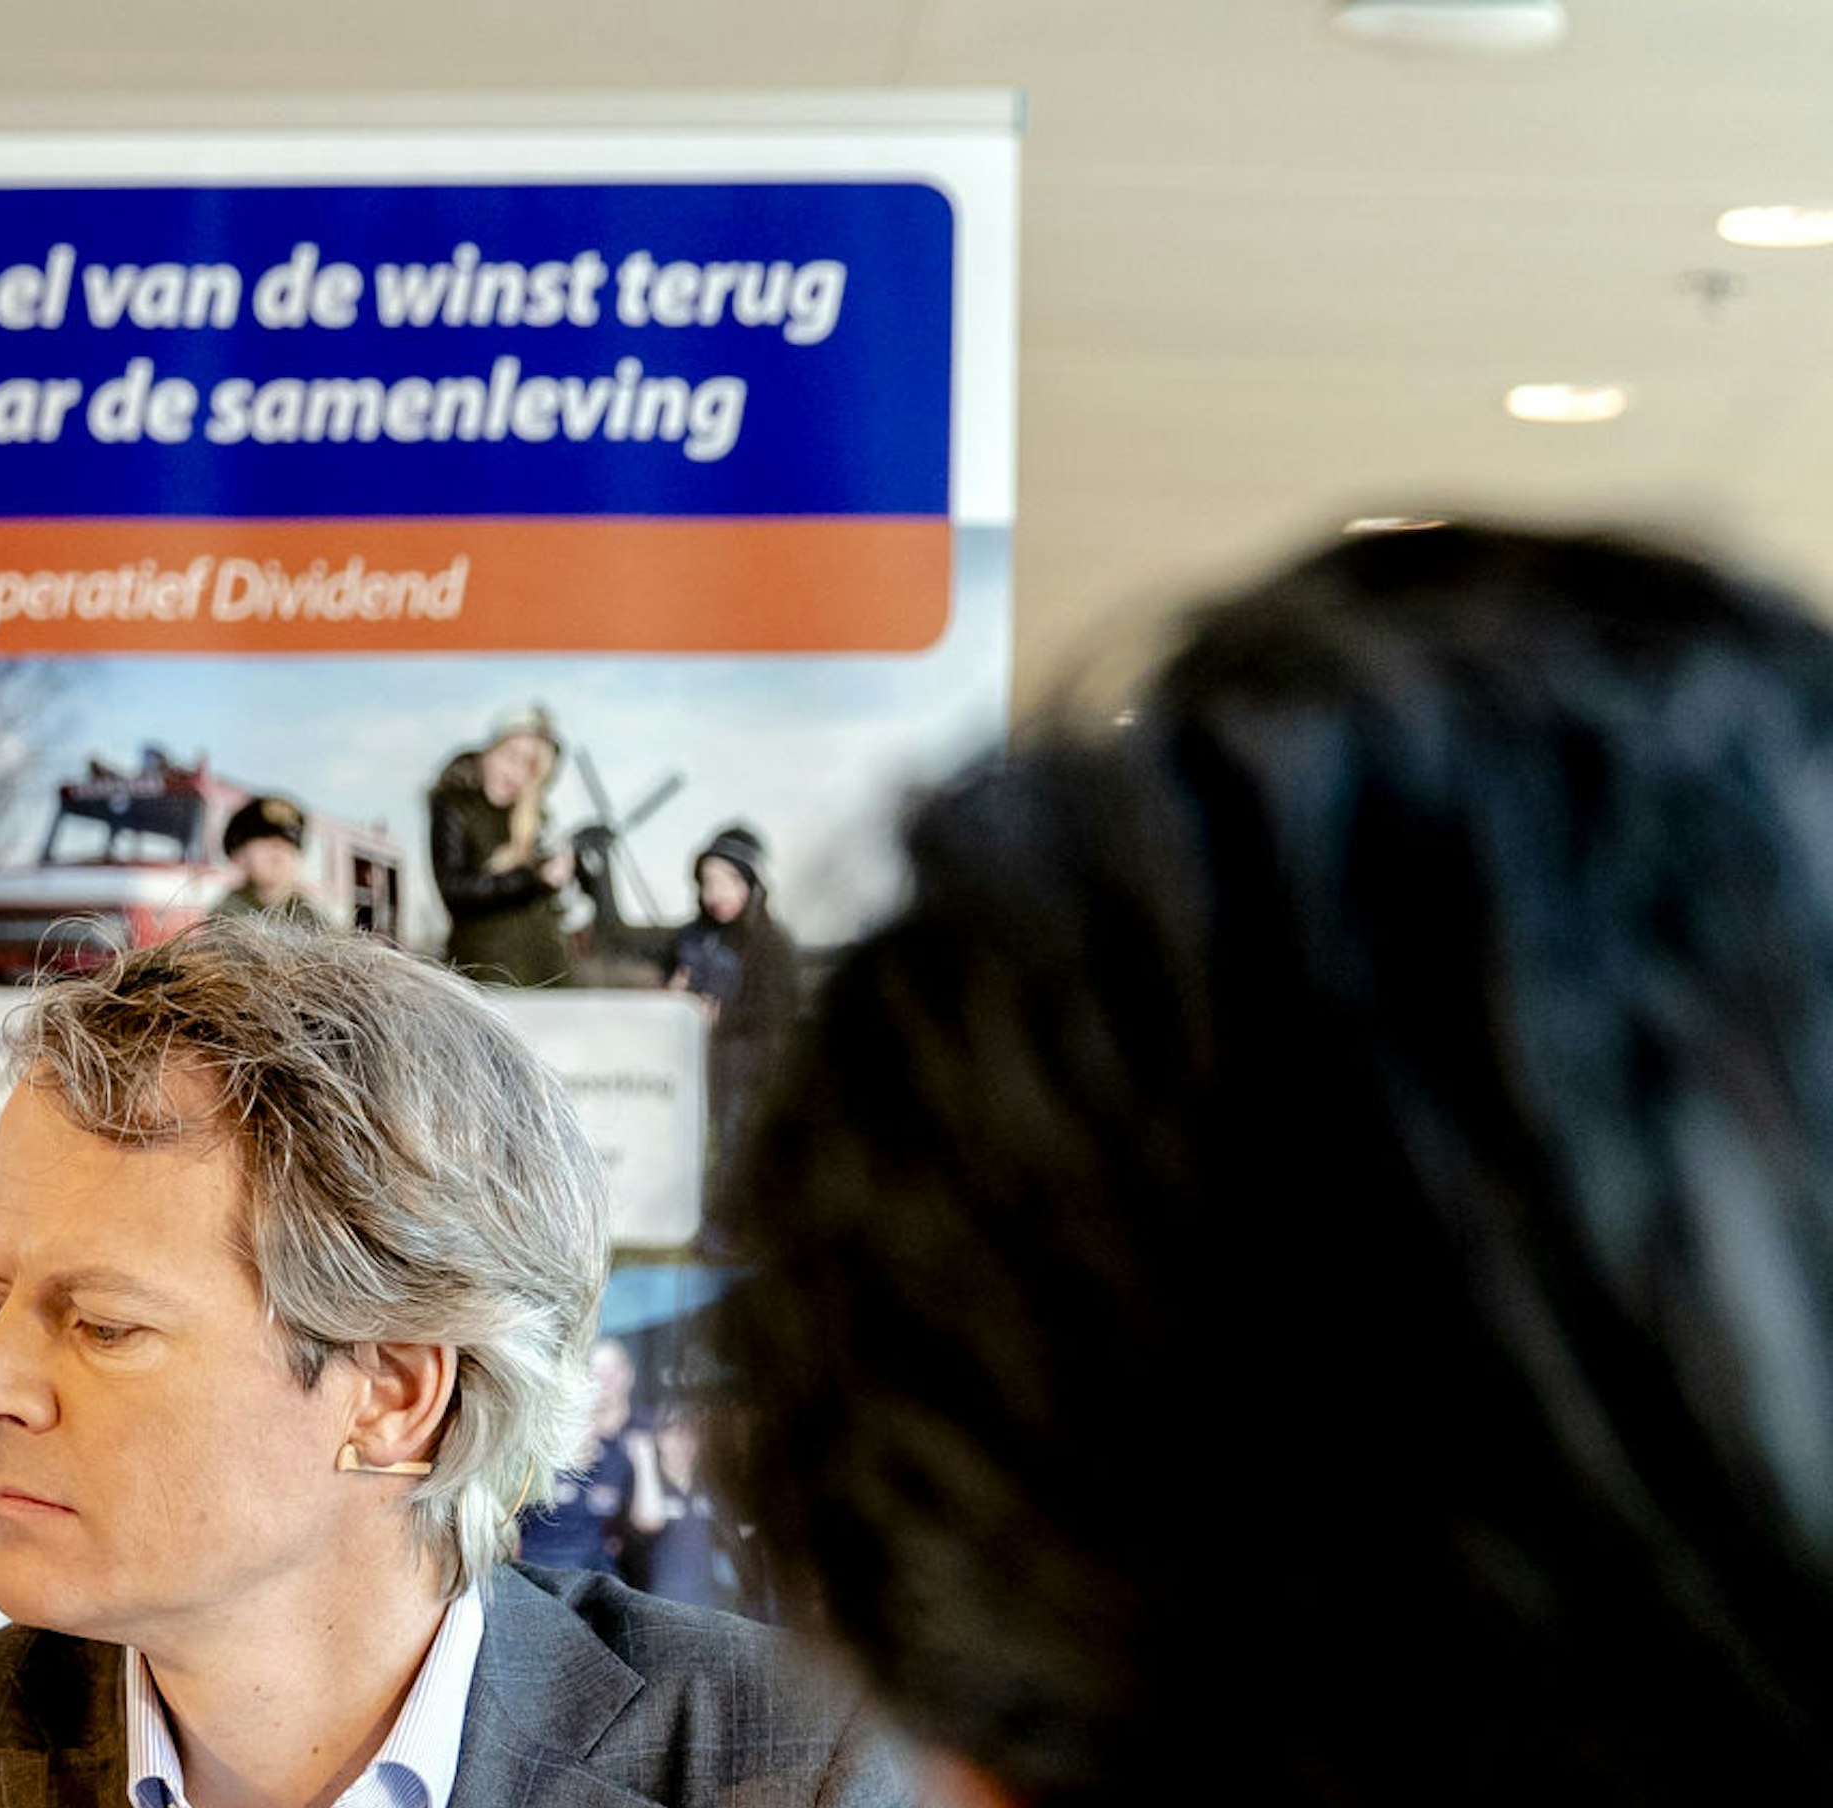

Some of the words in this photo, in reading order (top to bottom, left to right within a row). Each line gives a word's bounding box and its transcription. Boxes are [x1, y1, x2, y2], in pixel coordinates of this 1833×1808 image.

[83, 262, 242, 330] van
[252, 242, 364, 330] de
[374, 242, 608, 328] winst
[615, 250, 847, 346] terug
[86, 356, 199, 444] de
[204, 356, 747, 463] samenleving
[212, 554, 471, 622] Dividend
